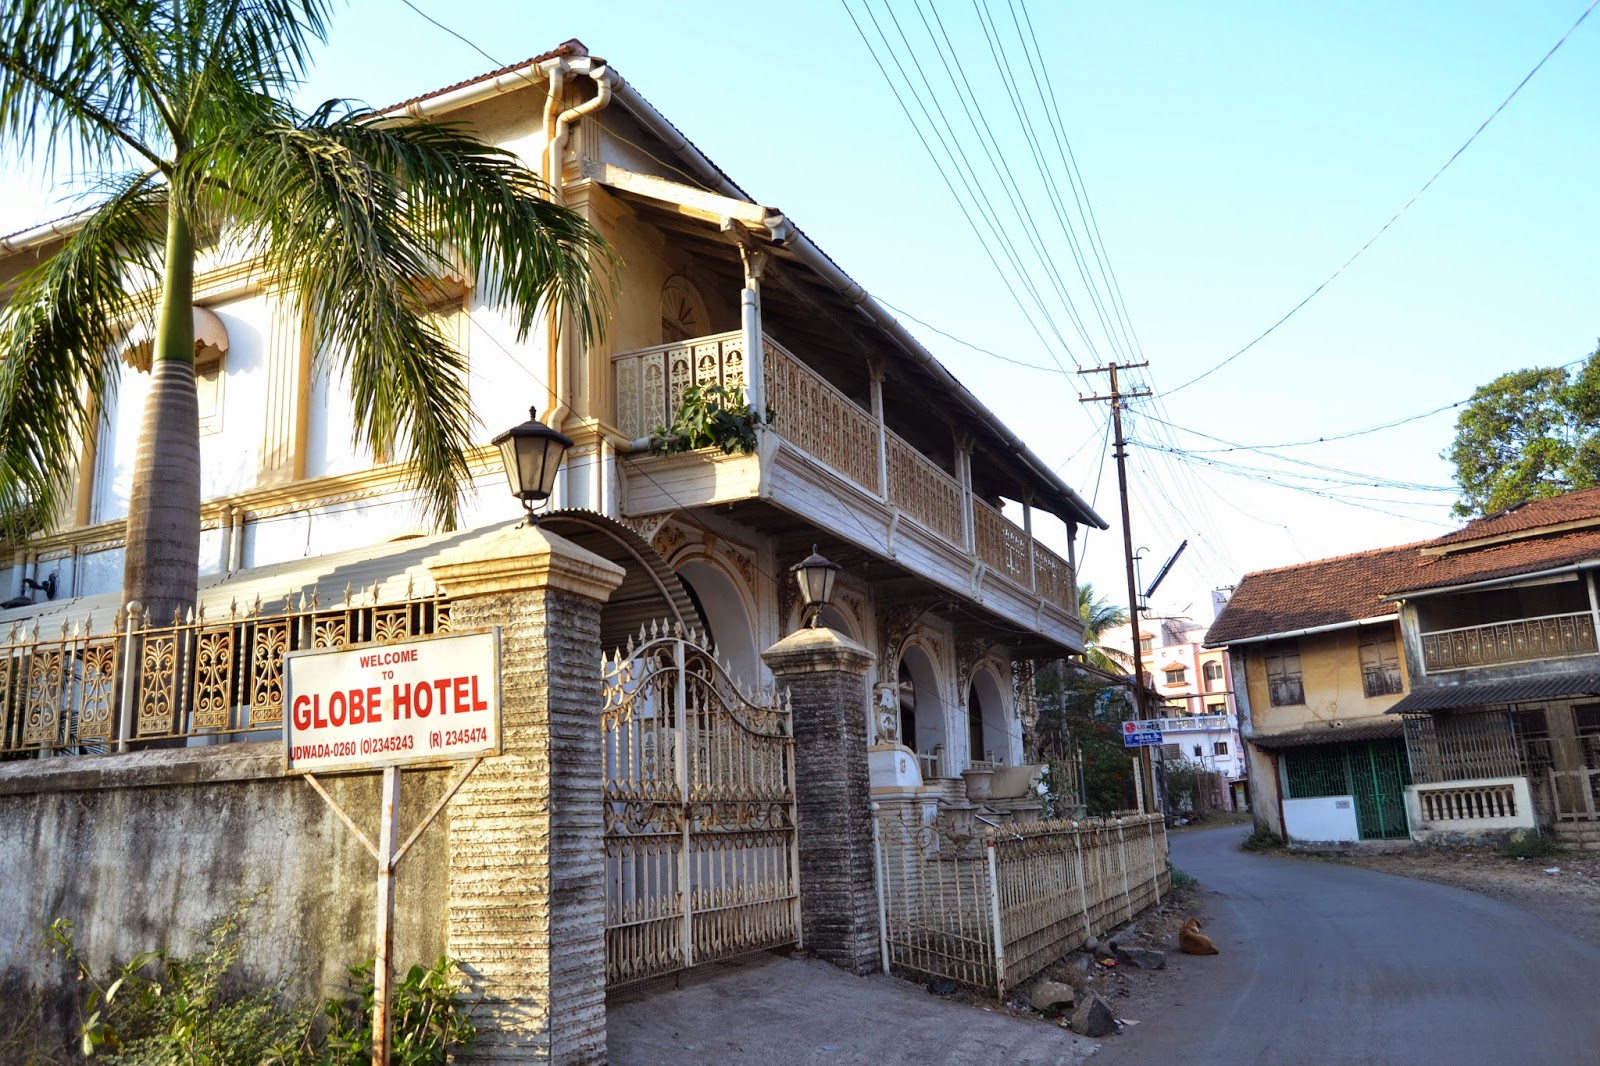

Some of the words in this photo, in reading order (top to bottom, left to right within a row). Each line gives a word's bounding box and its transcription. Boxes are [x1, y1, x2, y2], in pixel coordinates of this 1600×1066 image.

[360, 649, 418, 669] WELCOME
[382, 670, 394, 680] TO
[293, 686, 382, 731] GLOBE
[393, 675, 488, 720] HOTEL
[290, 741, 357, 761] UDWADA-0260
[429, 730, 442, 748] (R)
[446, 727, 487, 746] 2345474
